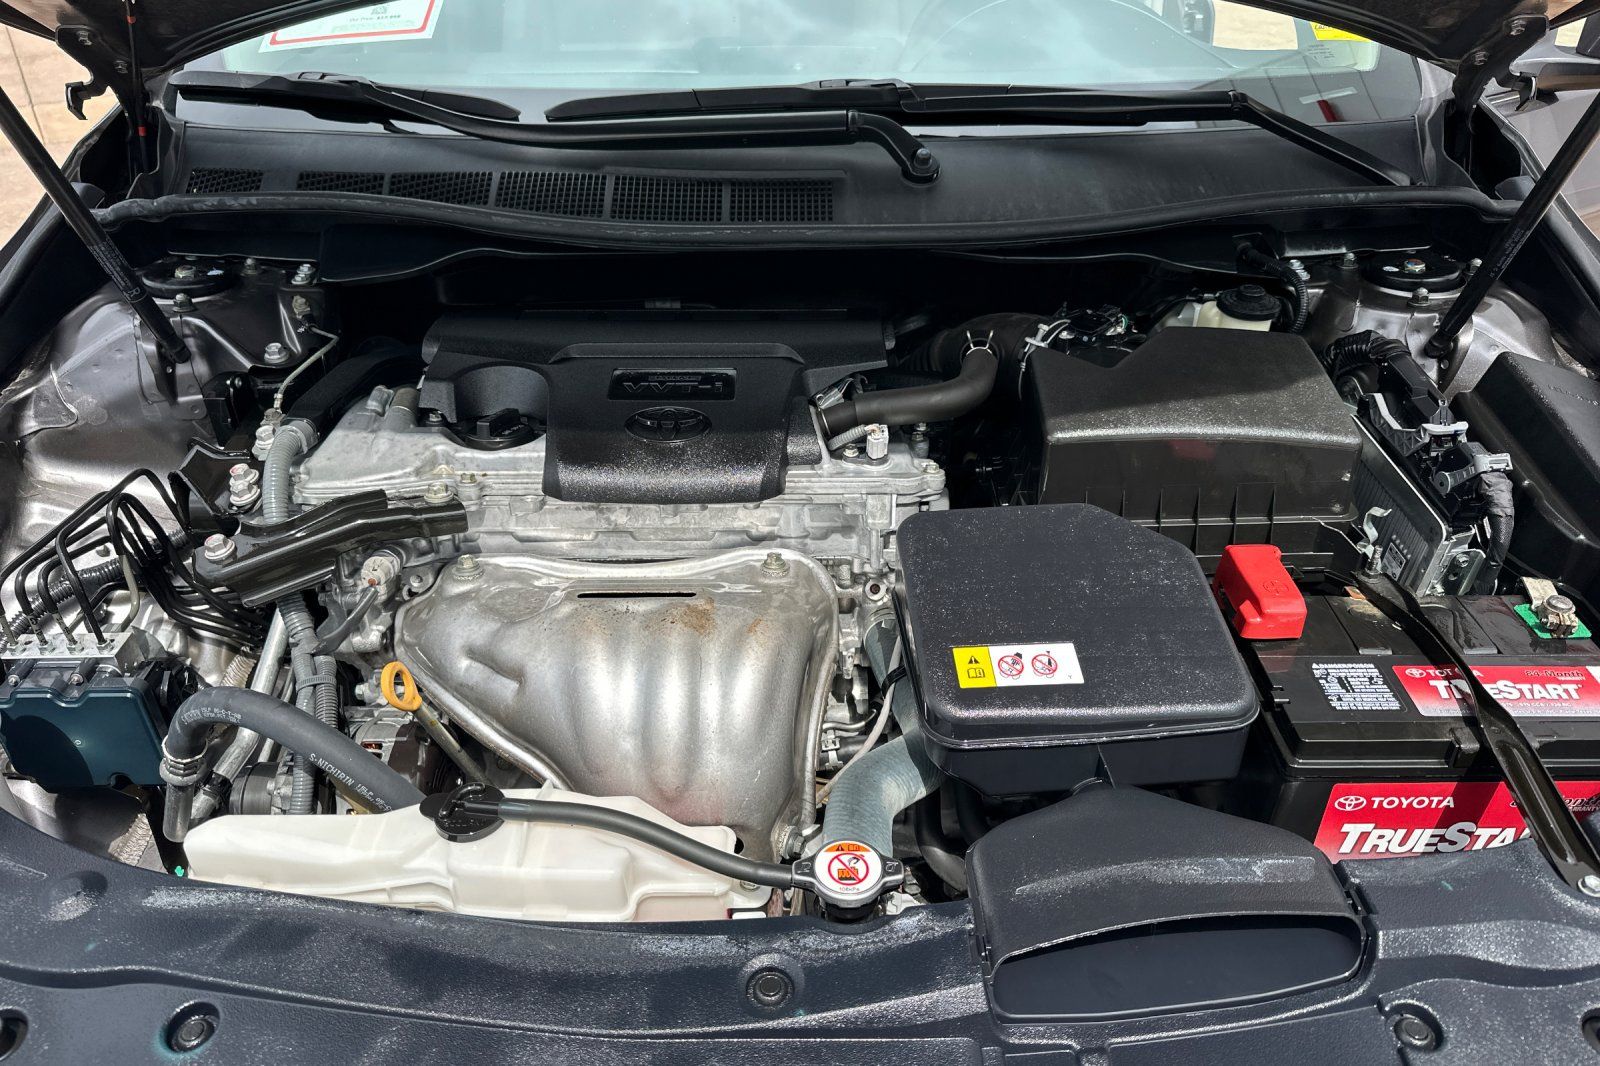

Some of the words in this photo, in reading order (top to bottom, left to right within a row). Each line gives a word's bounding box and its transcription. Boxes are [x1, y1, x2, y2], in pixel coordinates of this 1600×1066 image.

[128, 288, 141, 297] R
[622, 382, 724, 393] VVT-i
[1426, 668, 1484, 678] TOYA
[1428, 679, 1581, 700] TRESTART
[1371, 796, 1455, 809] TOYOTA
[1338, 821, 1530, 854] TRUESTA
